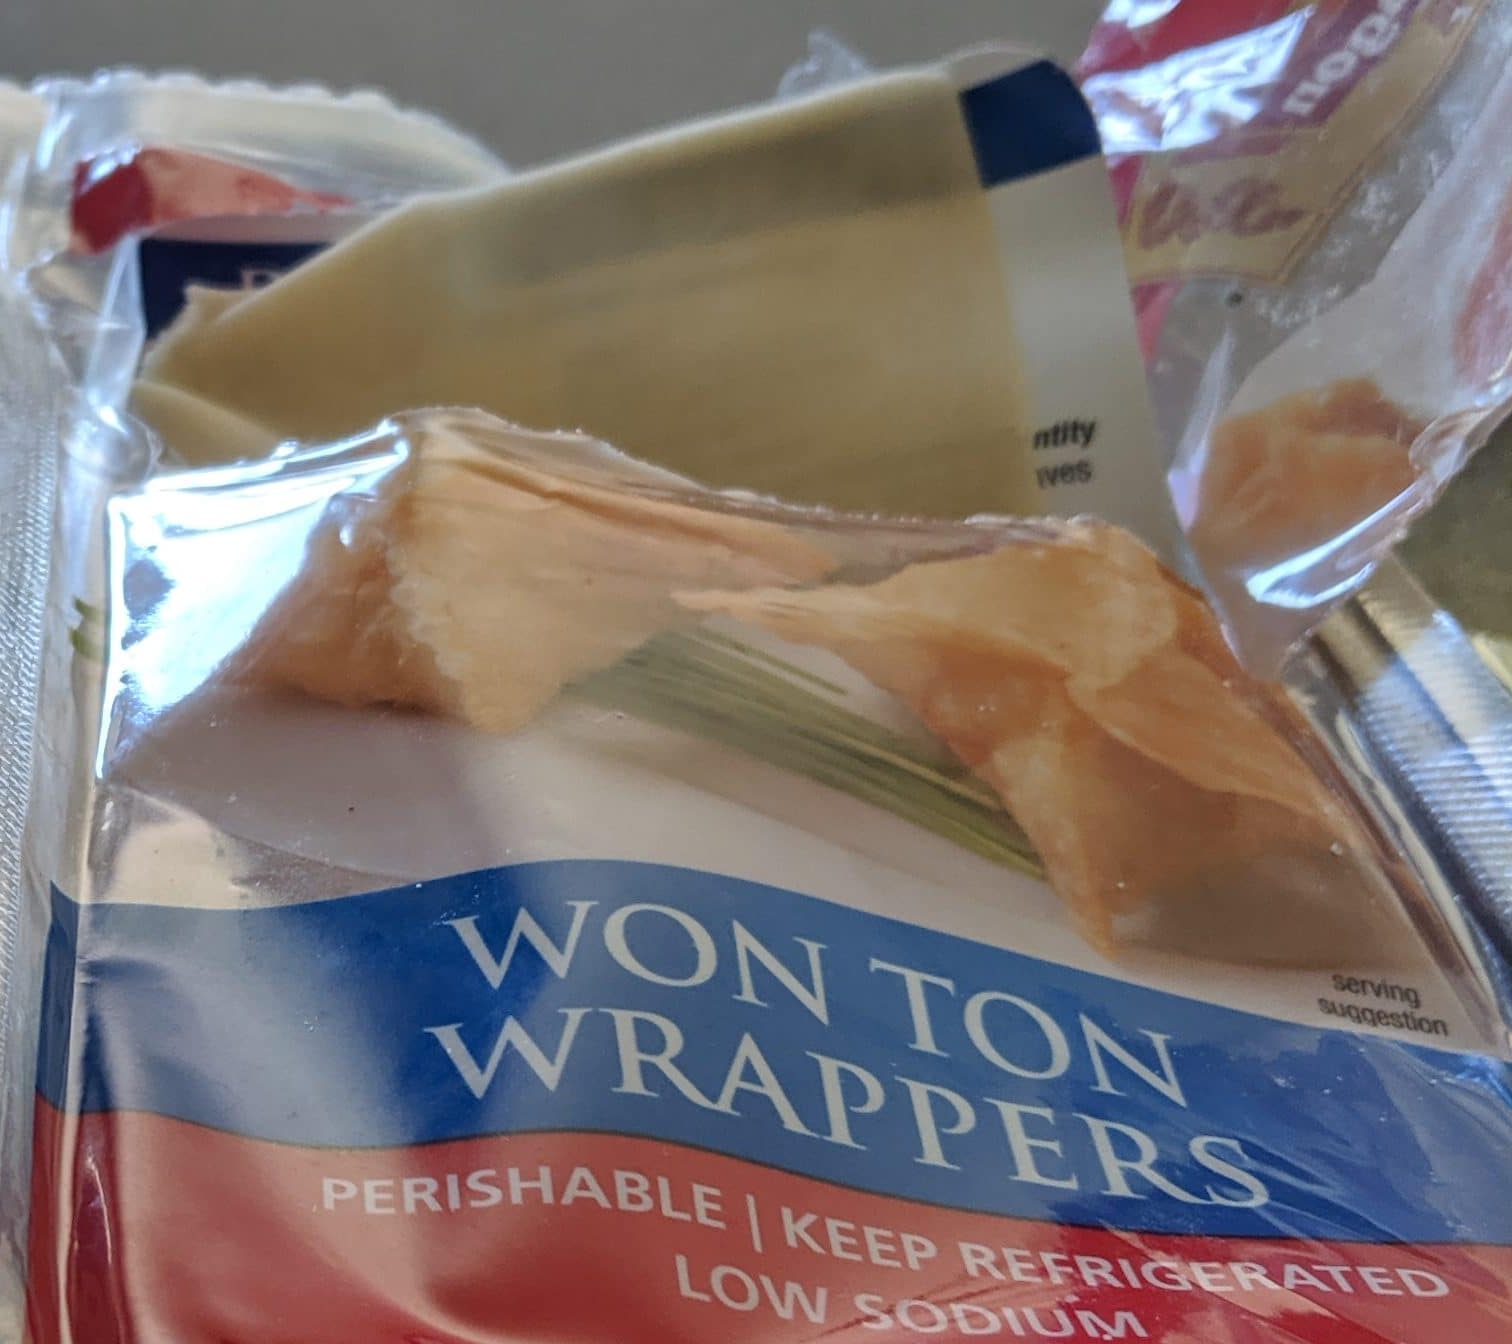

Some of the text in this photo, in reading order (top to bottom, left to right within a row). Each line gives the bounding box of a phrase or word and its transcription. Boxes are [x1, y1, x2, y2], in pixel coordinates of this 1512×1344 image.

[445, 899, 1189, 1108] WON TON
[1317, 997, 1449, 1037] suggestion
[1331, 974, 1421, 1009] serving
[423, 1006, 1271, 1210] WRAPPERS
[321, 1165, 726, 1230] PERISHABLE
[781, 1205, 939, 1272] KEEP
[962, 1240, 1451, 1299] REFRIGERATED
[675, 1253, 1149, 1341] LOW SODIUM
